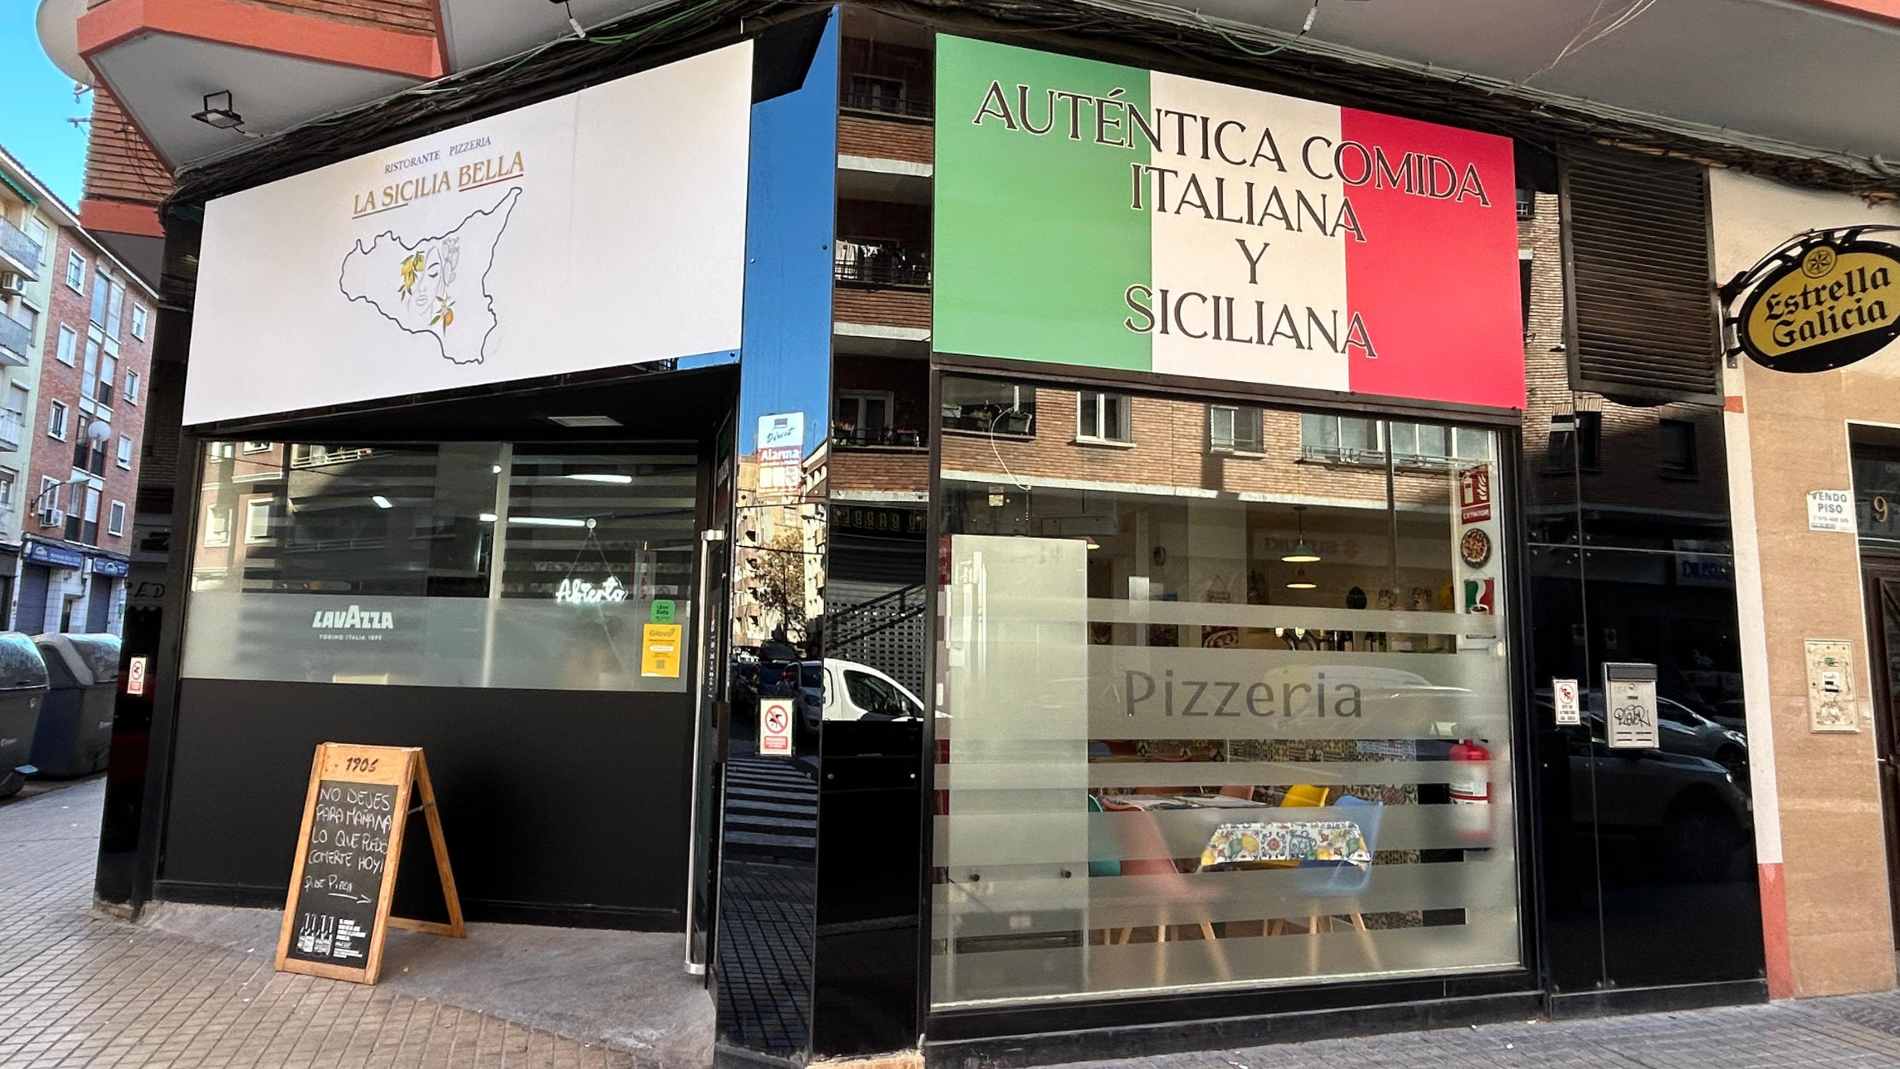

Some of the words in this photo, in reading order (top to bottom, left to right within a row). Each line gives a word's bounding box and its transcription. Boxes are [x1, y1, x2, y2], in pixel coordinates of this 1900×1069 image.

[384, 150, 441, 174] RISTORANTE
[449, 136, 492, 156] PIZZERIA
[974, 80, 1288, 172] AUTÉNTICA
[1302, 135, 1492, 207] COMIDA
[353, 191, 376, 215] LA
[382, 171, 451, 206] SICILIA
[458, 151, 524, 187] BELLA
[1130, 163, 1367, 242] ITALIANA
[1235, 239, 1271, 284] Y
[1765, 265, 1892, 323] Estrella
[1124, 285, 1377, 358] SICILIANA
[1771, 297, 1888, 348] Galicia
[1812, 491, 1848, 503] VENDO
[1817, 503, 1844, 514] PISO
[1873, 495, 1889, 522] 9
[555, 576, 627, 604] Abierto
[312, 604, 394, 629] LAVAZZA
[1125, 669, 1362, 718] Pizzeria
[320, 787, 341, 802] NO
[347, 788, 391, 811] DEJES
[312, 826, 328, 844] LO
[335, 830, 361, 848] QUE
[316, 804, 344, 824] PARA
[346, 807, 392, 834] MAÑANA
